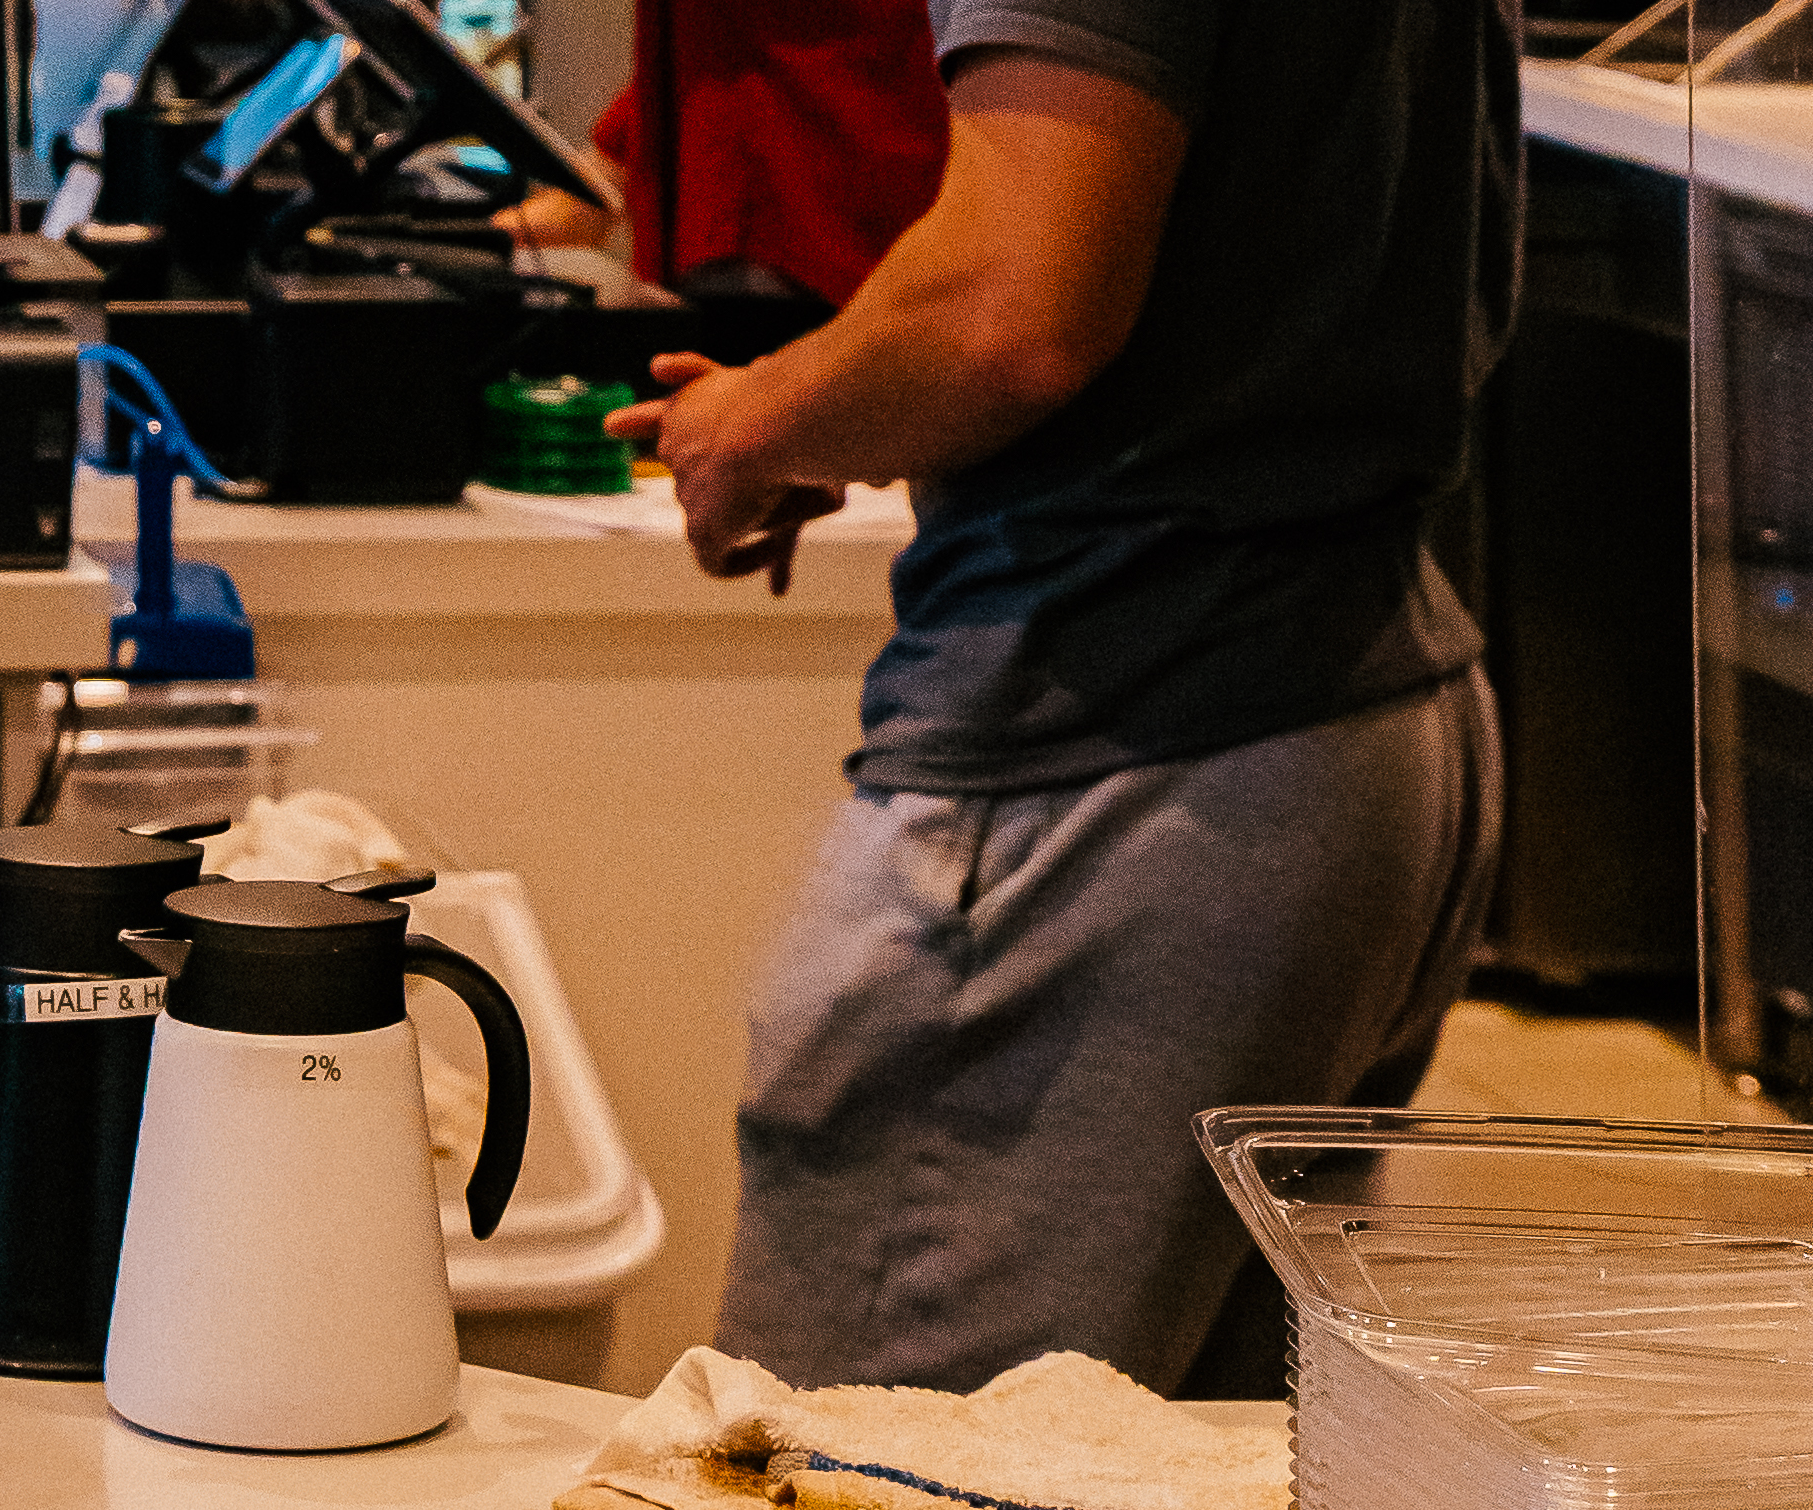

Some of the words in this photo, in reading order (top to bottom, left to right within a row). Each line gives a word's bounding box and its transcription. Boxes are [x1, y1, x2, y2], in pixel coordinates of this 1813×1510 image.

[37, 987, 109, 1014] HALF
[118, 984, 135, 1010] &
[301, 1054, 342, 1081] 2%
